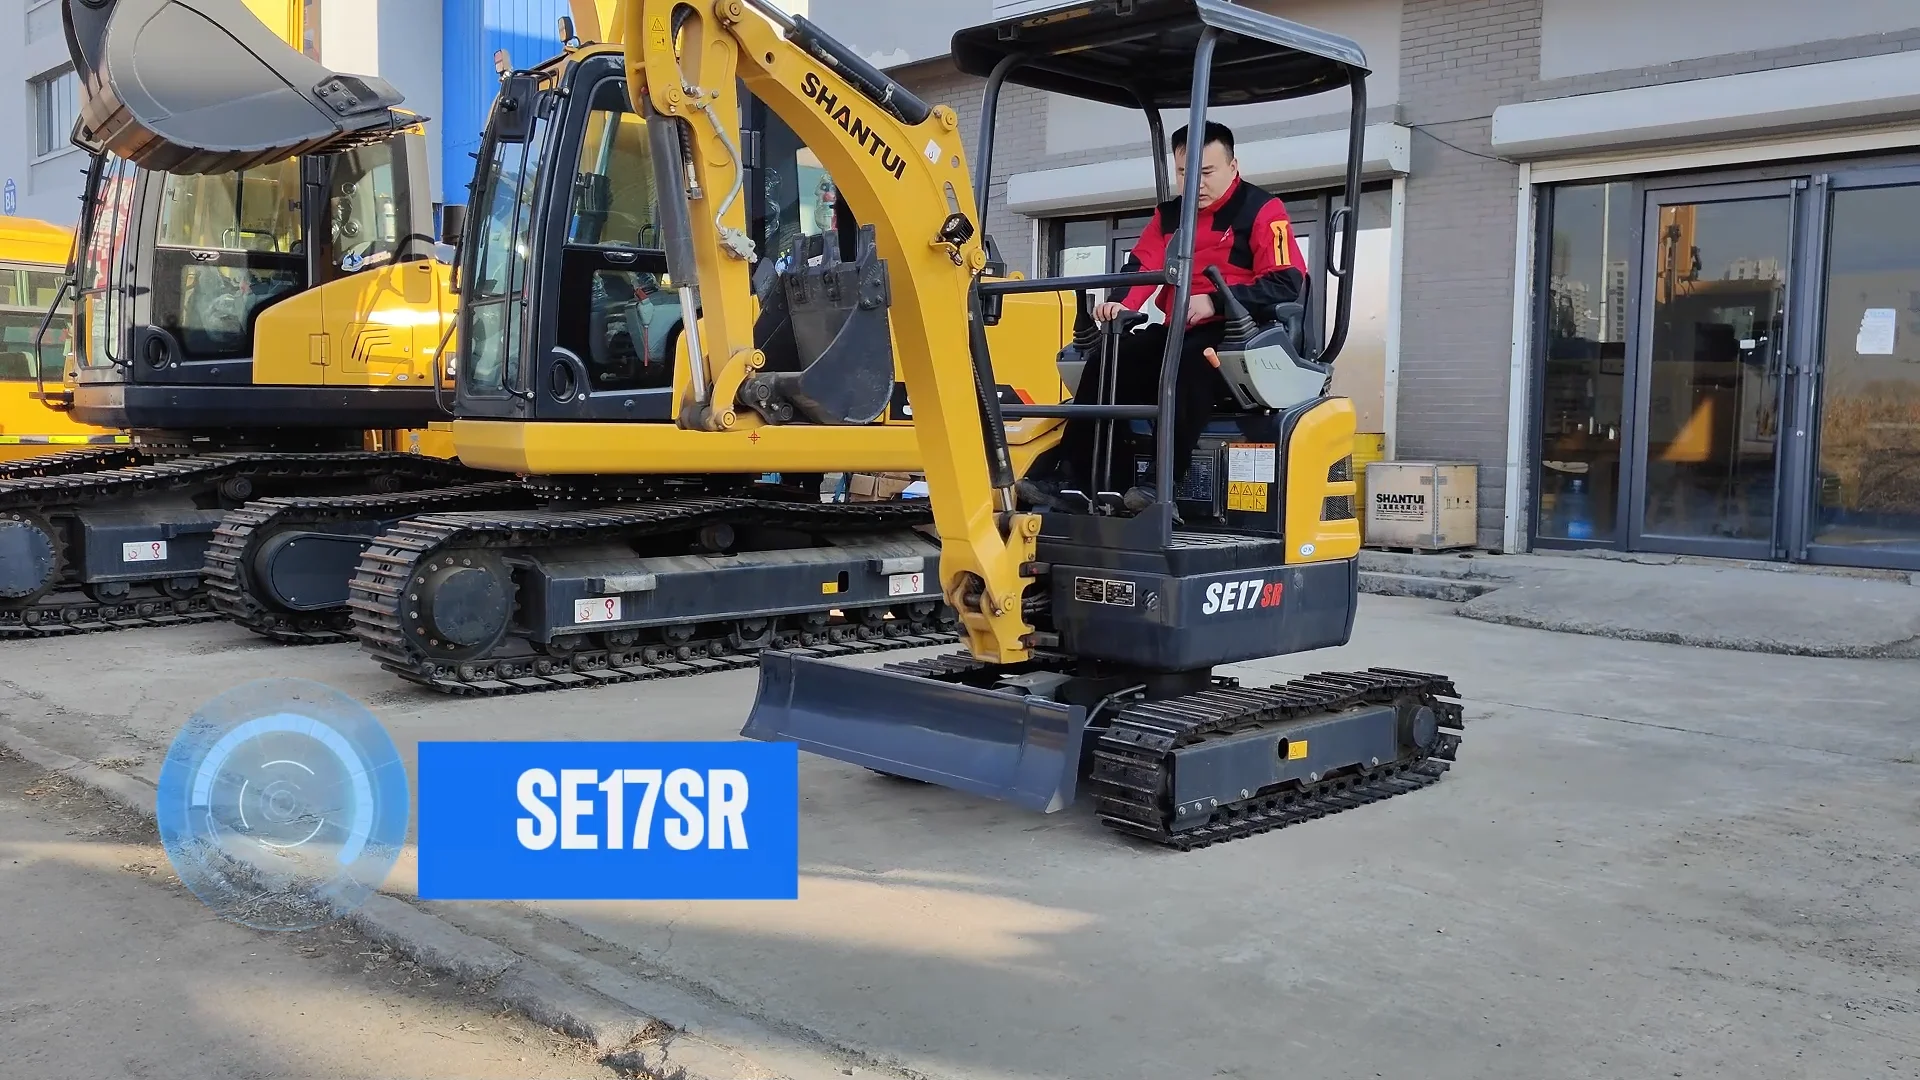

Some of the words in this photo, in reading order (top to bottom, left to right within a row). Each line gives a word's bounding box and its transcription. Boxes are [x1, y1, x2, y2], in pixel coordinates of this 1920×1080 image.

[801, 72, 907, 181] SHANTUI
[5, 191, 15, 211] B4
[1376, 493, 1424, 504] SHANTUI
